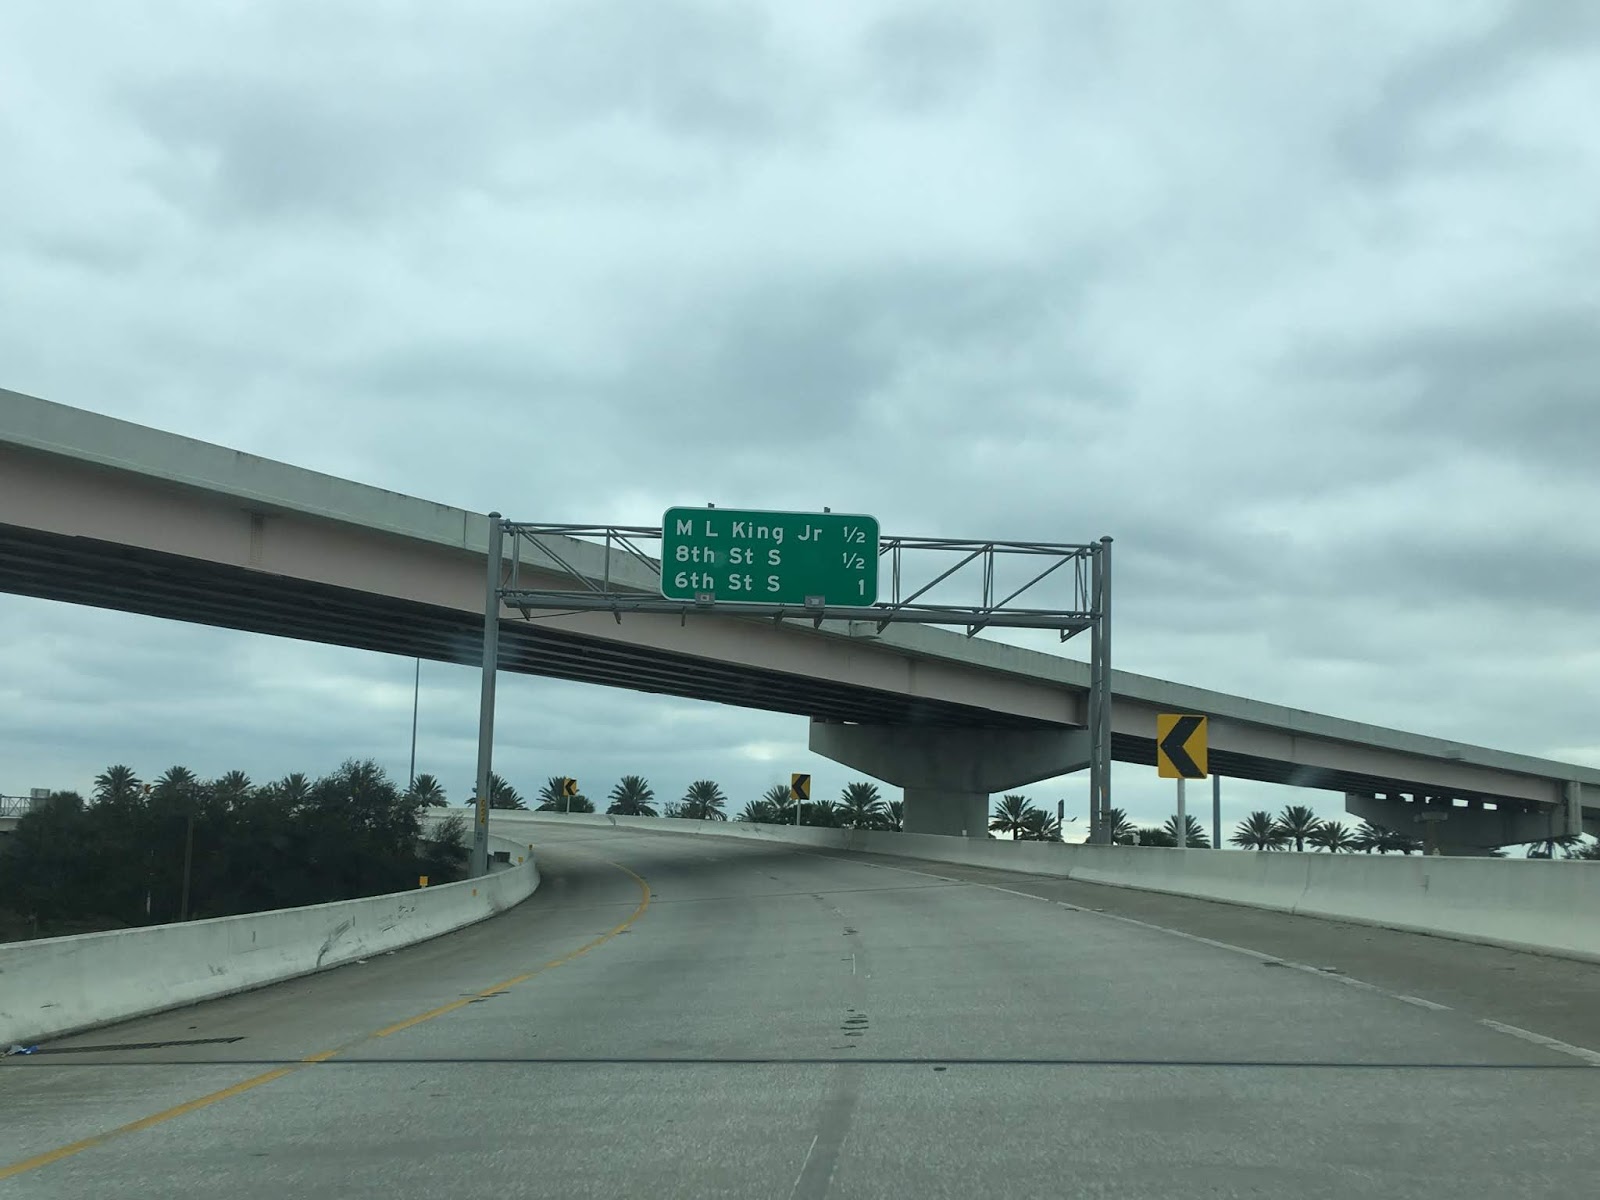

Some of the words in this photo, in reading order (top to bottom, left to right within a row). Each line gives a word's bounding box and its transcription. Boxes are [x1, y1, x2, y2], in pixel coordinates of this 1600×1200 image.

[676, 519, 692, 536] M
[706, 520, 718, 537] L
[732, 521, 783, 545] King
[797, 524, 822, 541] Jr
[675, 545, 715, 563] 8th
[729, 547, 753, 565] St
[767, 549, 781, 566] S
[674, 571, 714, 589] 6th
[728, 573, 753, 591] St
[767, 575, 780, 592] S
[858, 579, 865, 596] 1
